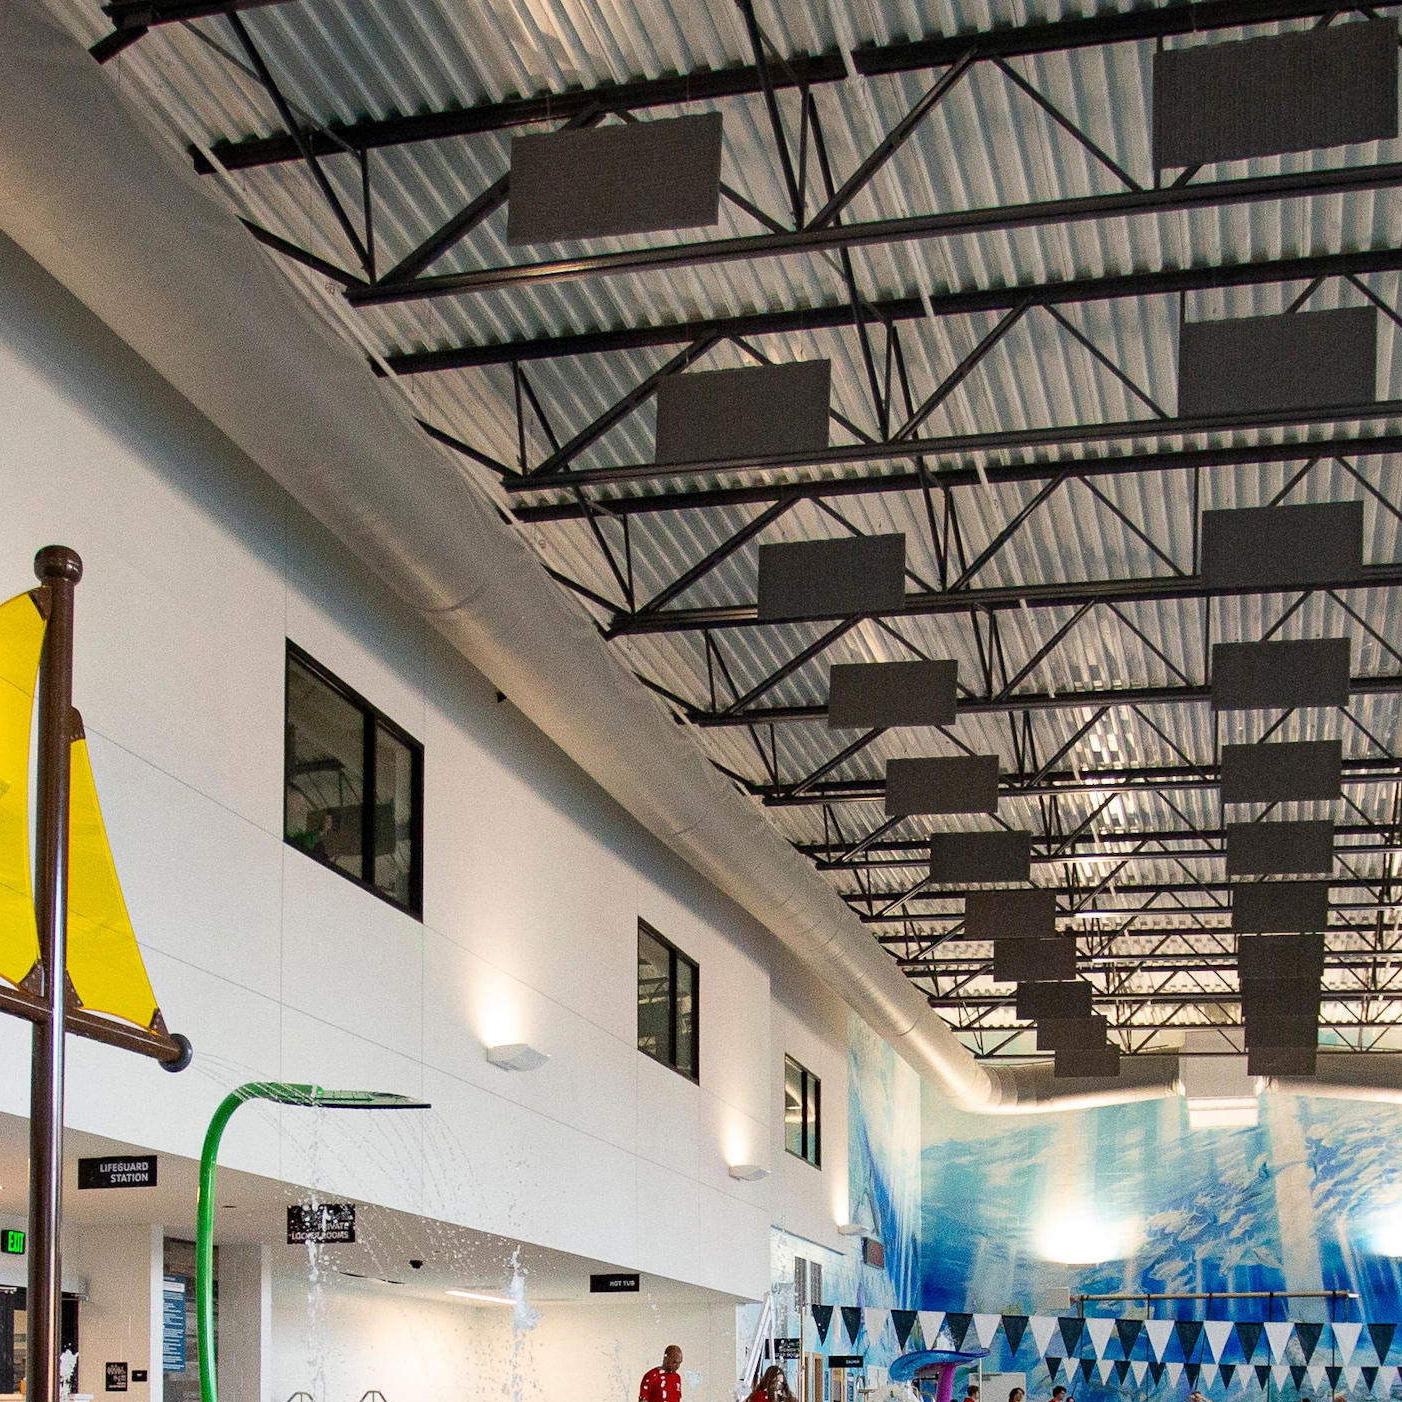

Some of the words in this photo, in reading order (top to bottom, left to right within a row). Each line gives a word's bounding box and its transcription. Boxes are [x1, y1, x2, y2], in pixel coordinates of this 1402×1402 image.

[99, 1162, 149, 1173] LIFEGUARD
[110, 1173, 149, 1183] STATION
[8, 1230, 25, 1254] EXIT
